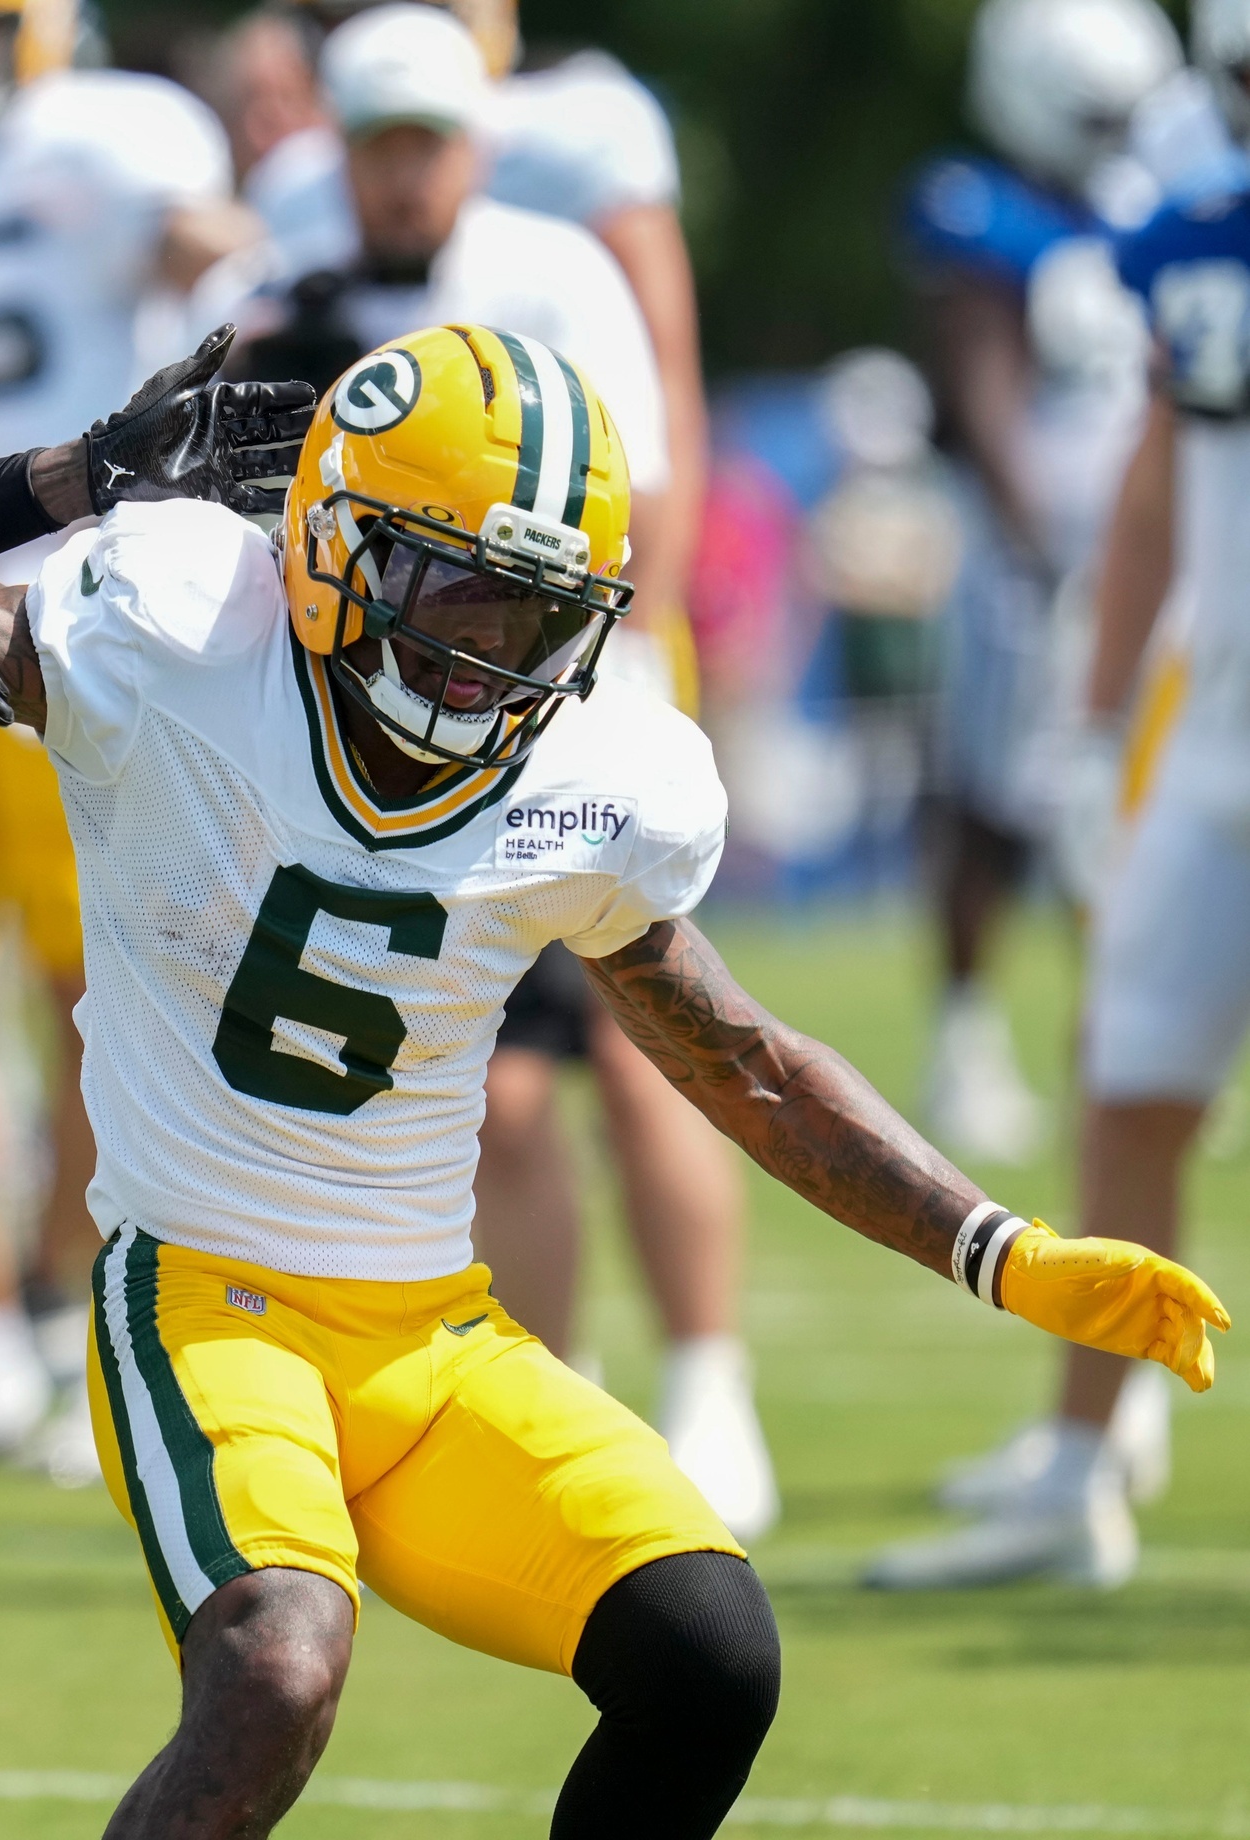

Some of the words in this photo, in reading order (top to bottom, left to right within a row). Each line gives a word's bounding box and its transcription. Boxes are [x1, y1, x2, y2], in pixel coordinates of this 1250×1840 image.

[523, 527, 562, 550] PACKERS
[506, 803, 630, 841] emplify
[506, 838, 564, 850] HEALTH
[505, 850, 515, 860] by
[212, 862, 448, 1116] 6
[233, 1293, 261, 1310] NFL
